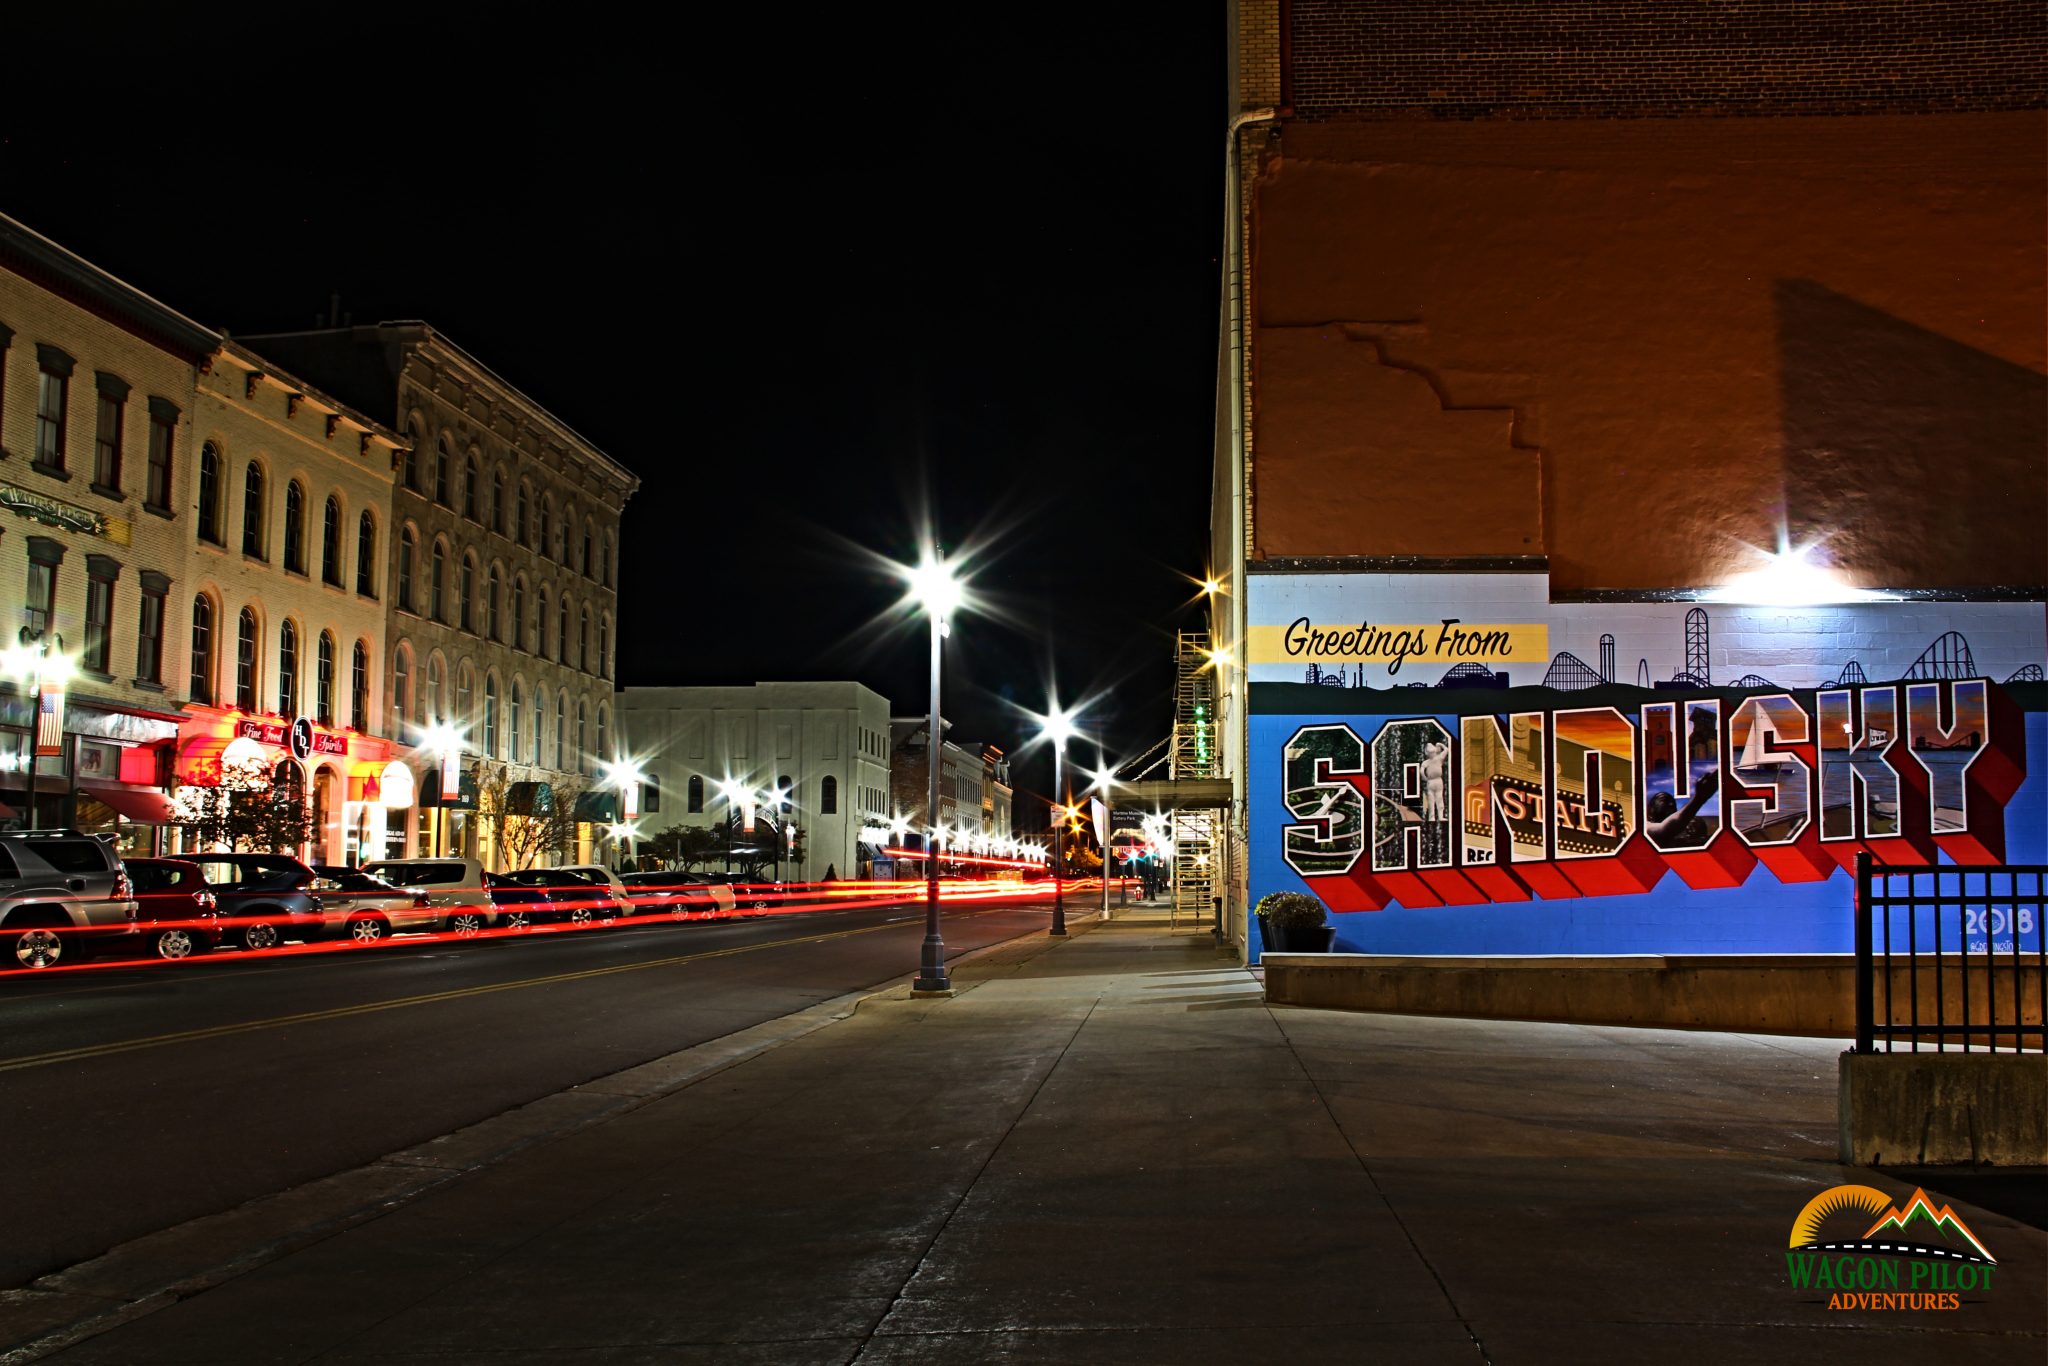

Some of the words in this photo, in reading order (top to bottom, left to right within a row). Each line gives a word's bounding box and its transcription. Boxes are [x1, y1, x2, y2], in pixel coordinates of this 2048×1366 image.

[1284, 617, 1428, 676] Greetings
[1435, 619, 1512, 657] From
[243, 723, 261, 739] Fine
[264, 726, 284, 743] Food
[319, 735, 343, 753] Spirits
[1282, 676, 1992, 880] SANDUSKY
[1502, 788, 1617, 838] STATE
[1960, 908, 2034, 935] 2018
